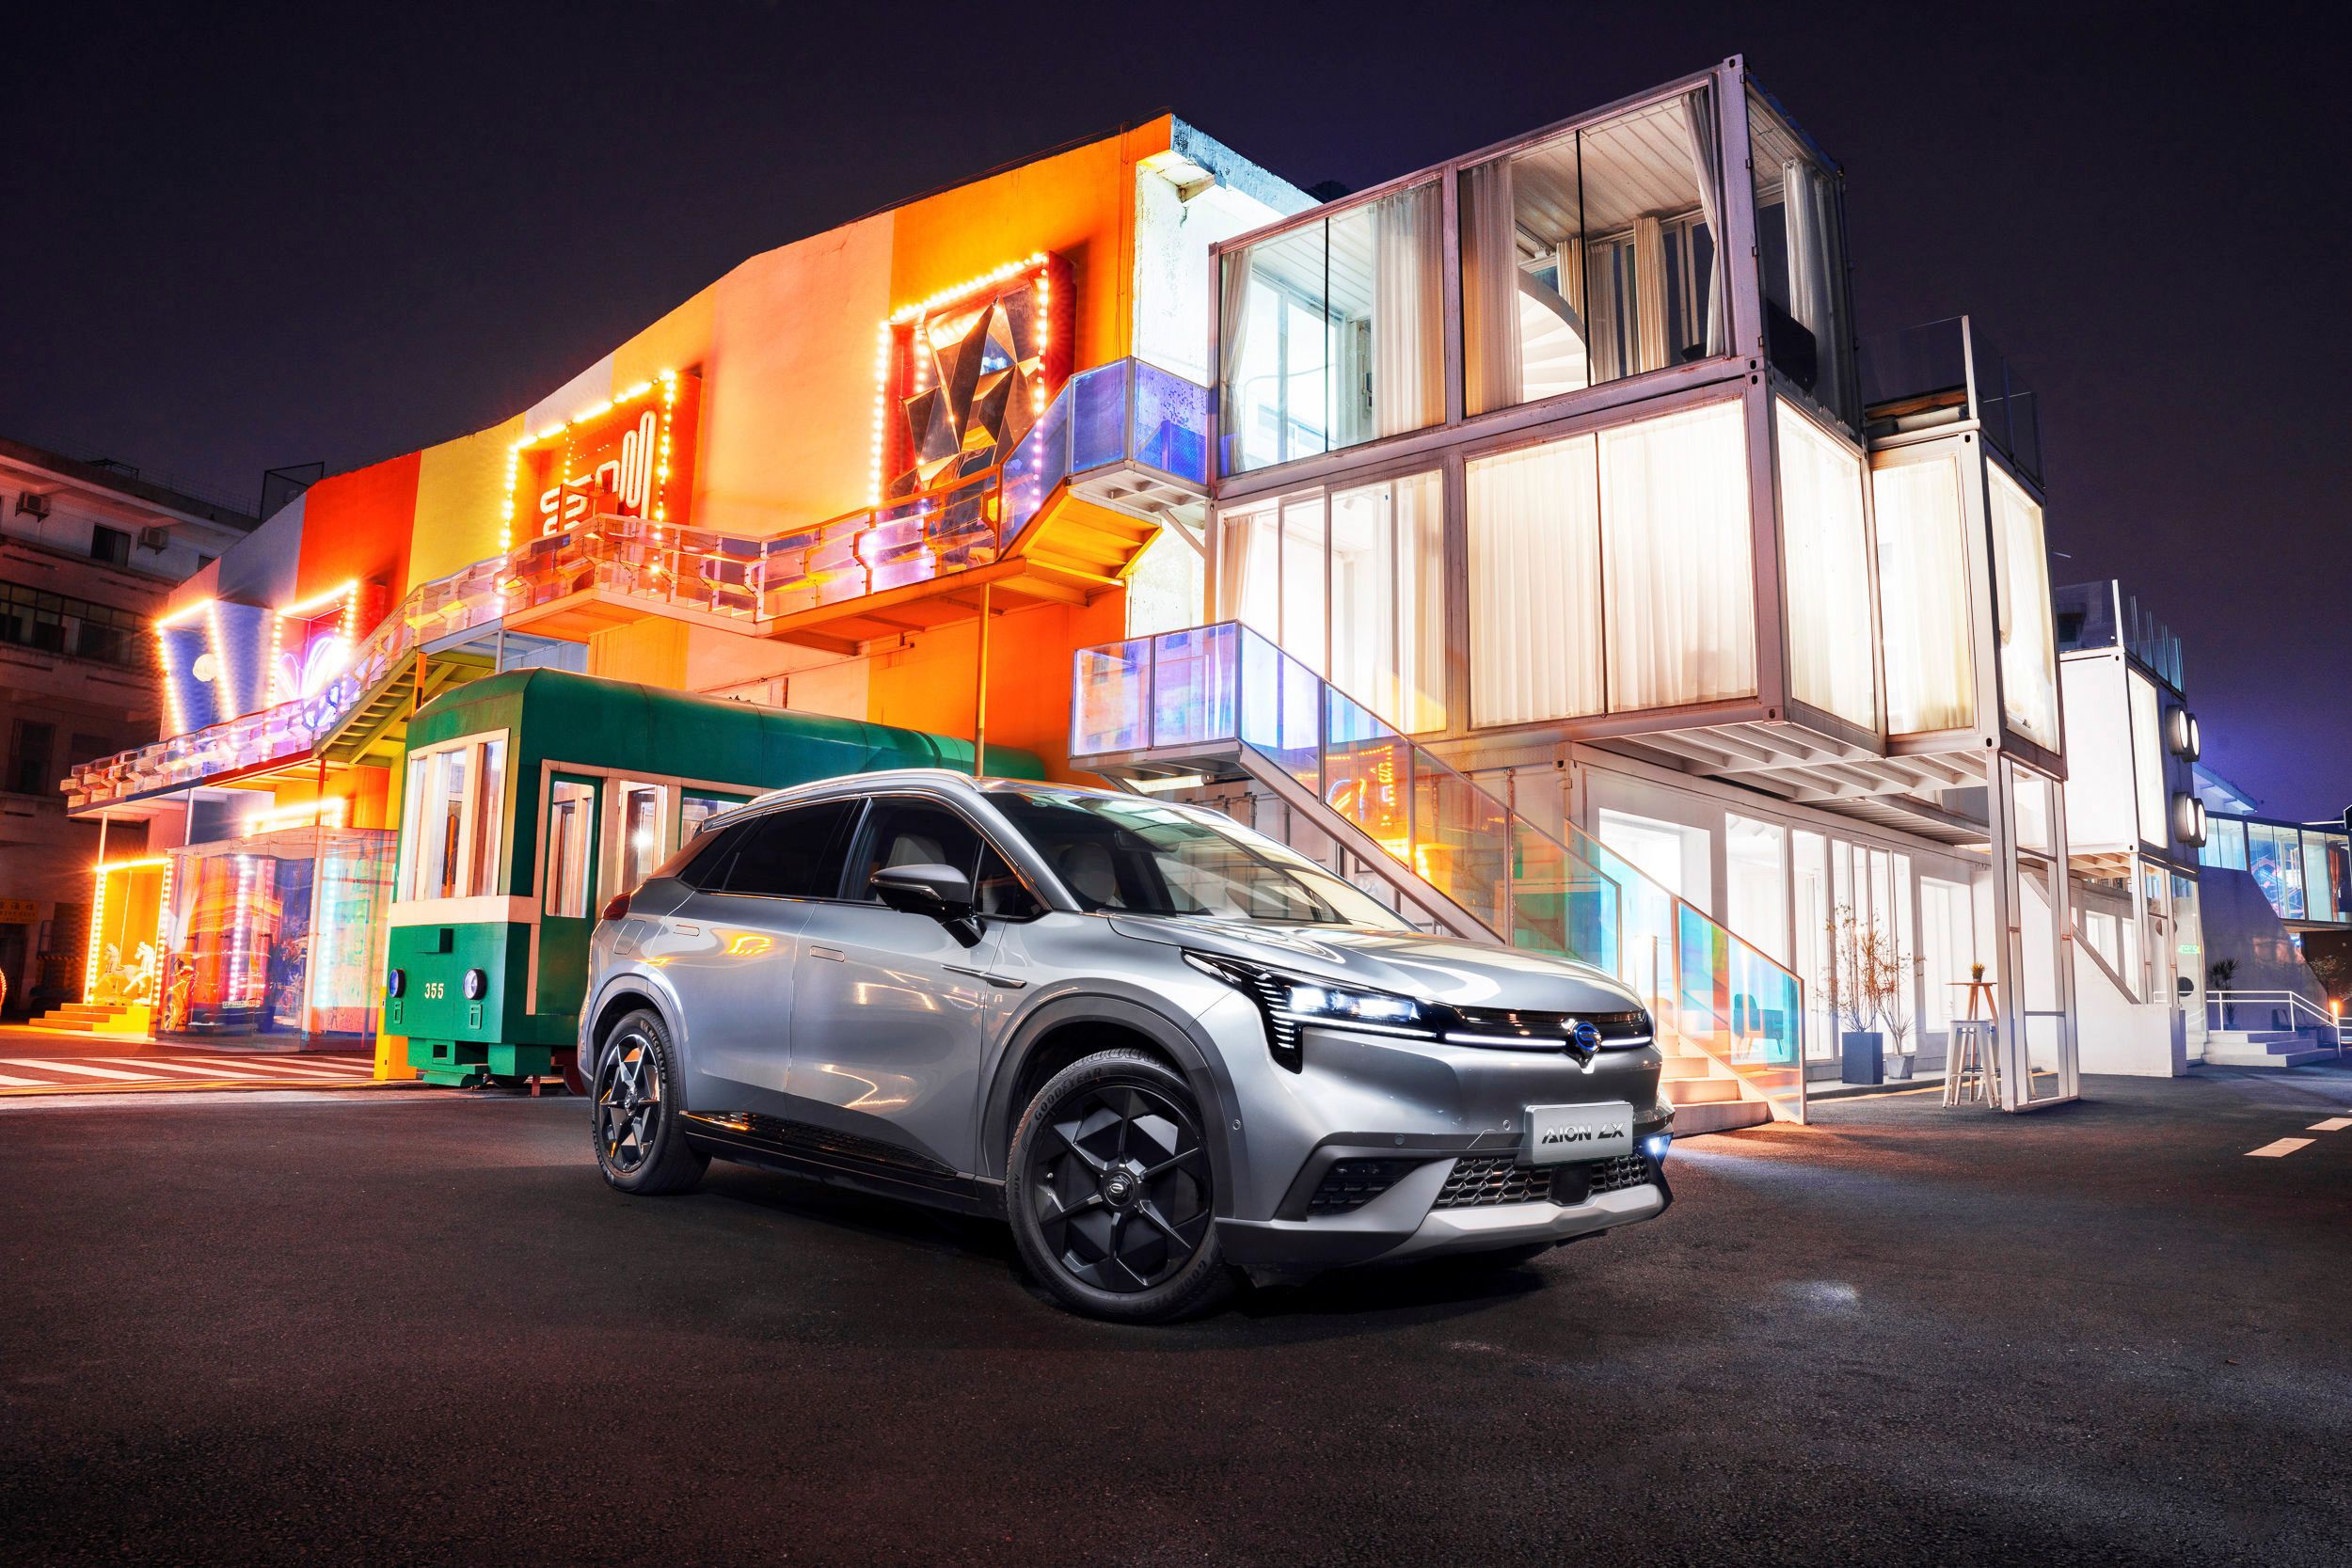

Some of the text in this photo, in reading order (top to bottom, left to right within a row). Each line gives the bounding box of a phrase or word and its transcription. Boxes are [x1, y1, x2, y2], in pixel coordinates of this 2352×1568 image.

[424, 982, 445, 1000] 355
[648, 1030, 667, 1082] MICHELIN
[1034, 1067, 1104, 1121] GOODYEAR
[1541, 1122, 1625, 1145] AION LX
